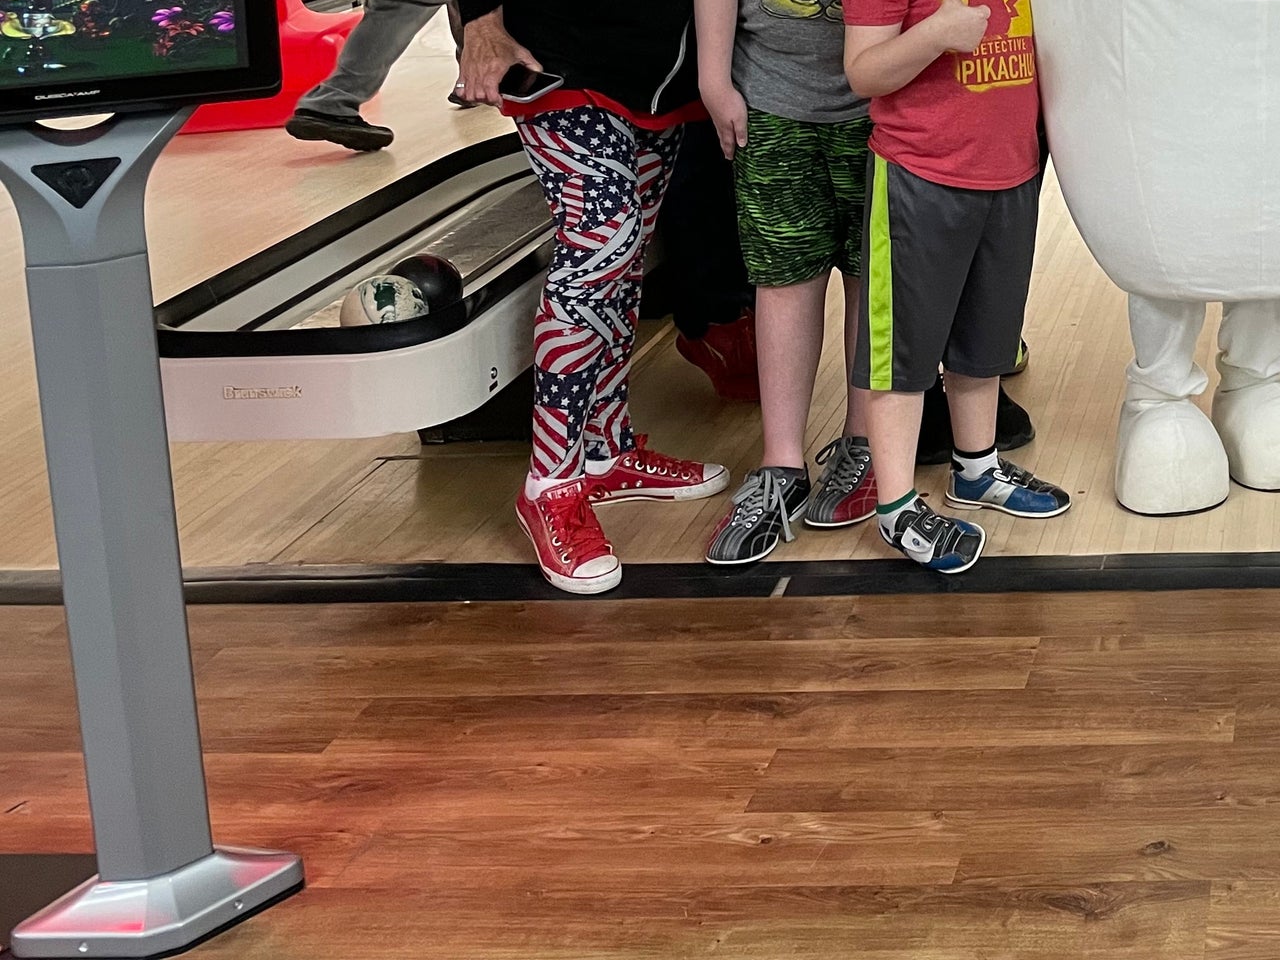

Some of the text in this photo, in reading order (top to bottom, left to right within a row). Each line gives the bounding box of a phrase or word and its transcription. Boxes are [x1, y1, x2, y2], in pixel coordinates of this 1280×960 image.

[973, 38, 1027, 56] DETECTIVE
[962, 52, 1034, 84] PIKACHU
[223, 385, 303, 400] Brunswick
